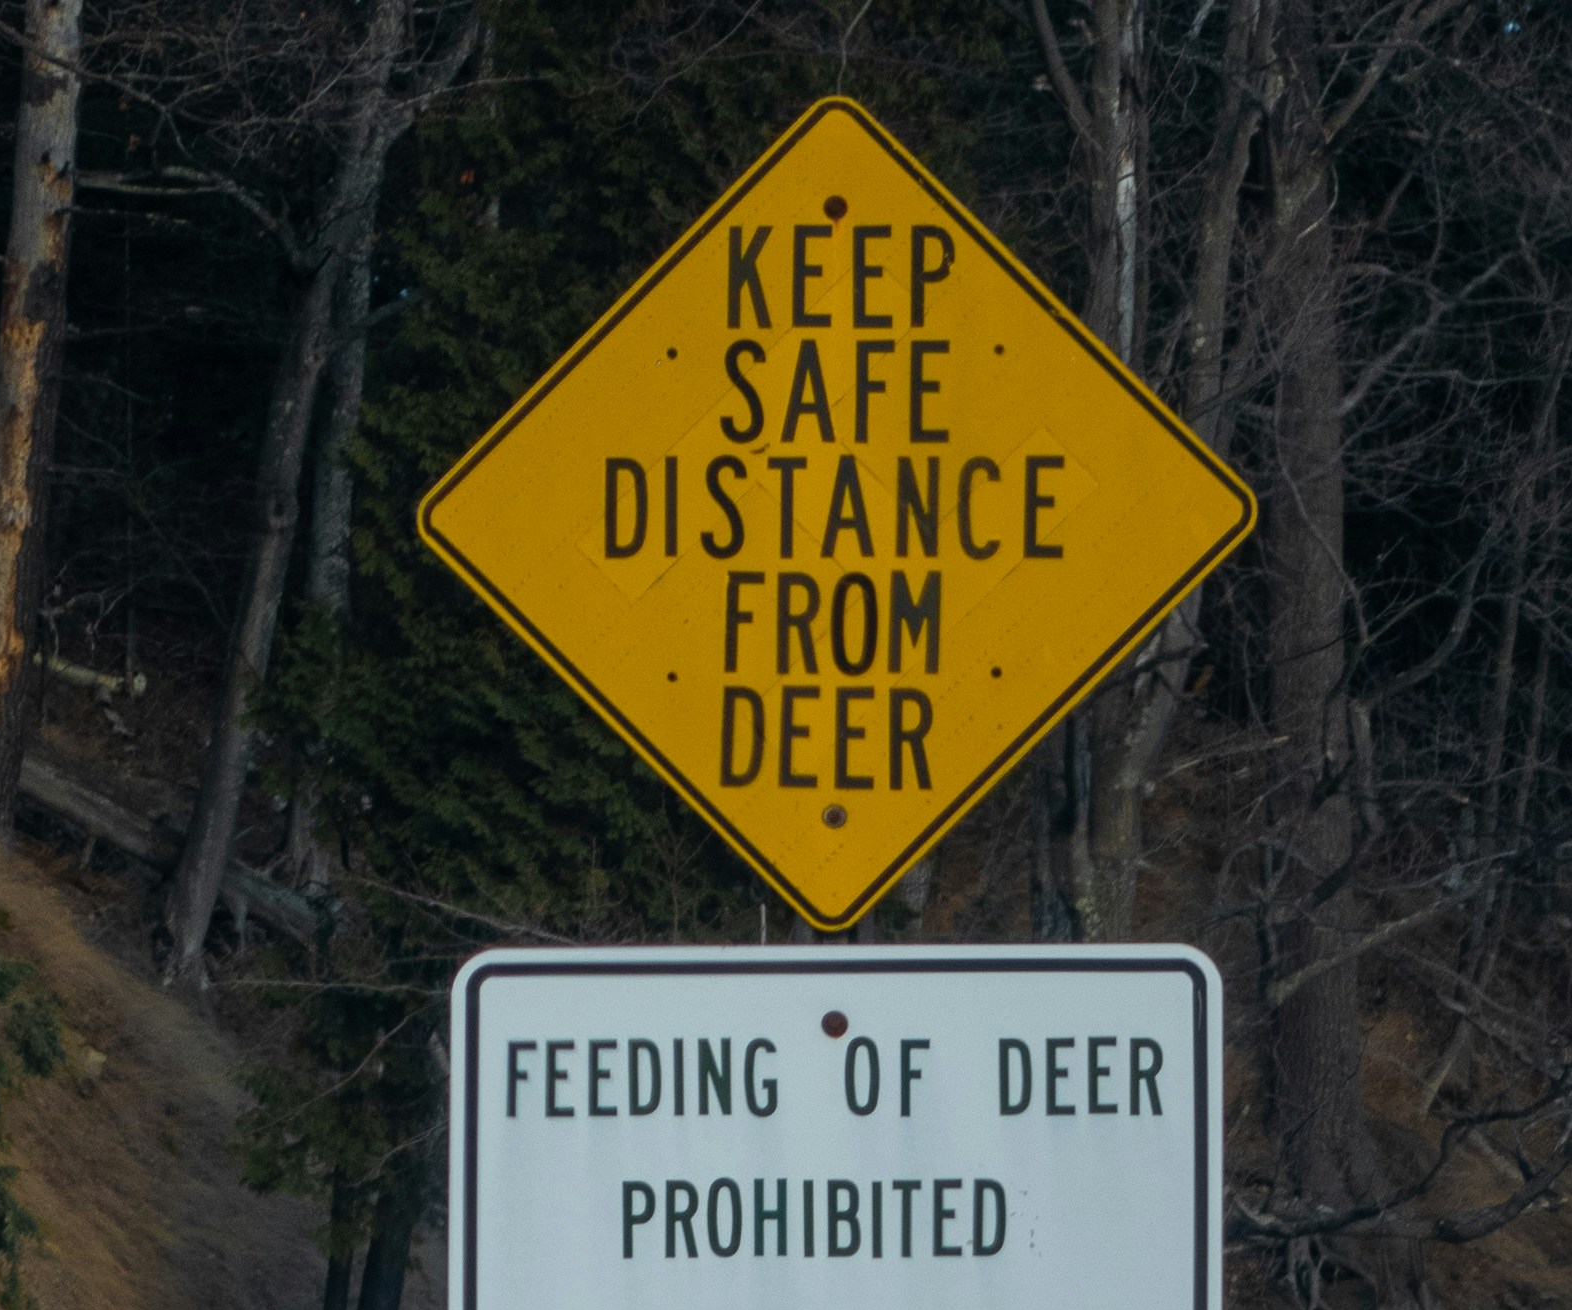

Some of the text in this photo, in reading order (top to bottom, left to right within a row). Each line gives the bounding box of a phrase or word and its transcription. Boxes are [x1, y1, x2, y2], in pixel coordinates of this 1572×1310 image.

[727, 224, 956, 329] KEEP
[719, 338, 950, 444] SAFE
[604, 454, 1065, 561] DISTANCE
[724, 570, 942, 677] FROM
[719, 685, 934, 791] DEER
[506, 1036, 1164, 1118] FEEDING OF DEER
[622, 1177, 1007, 1260] PROHIBITED
